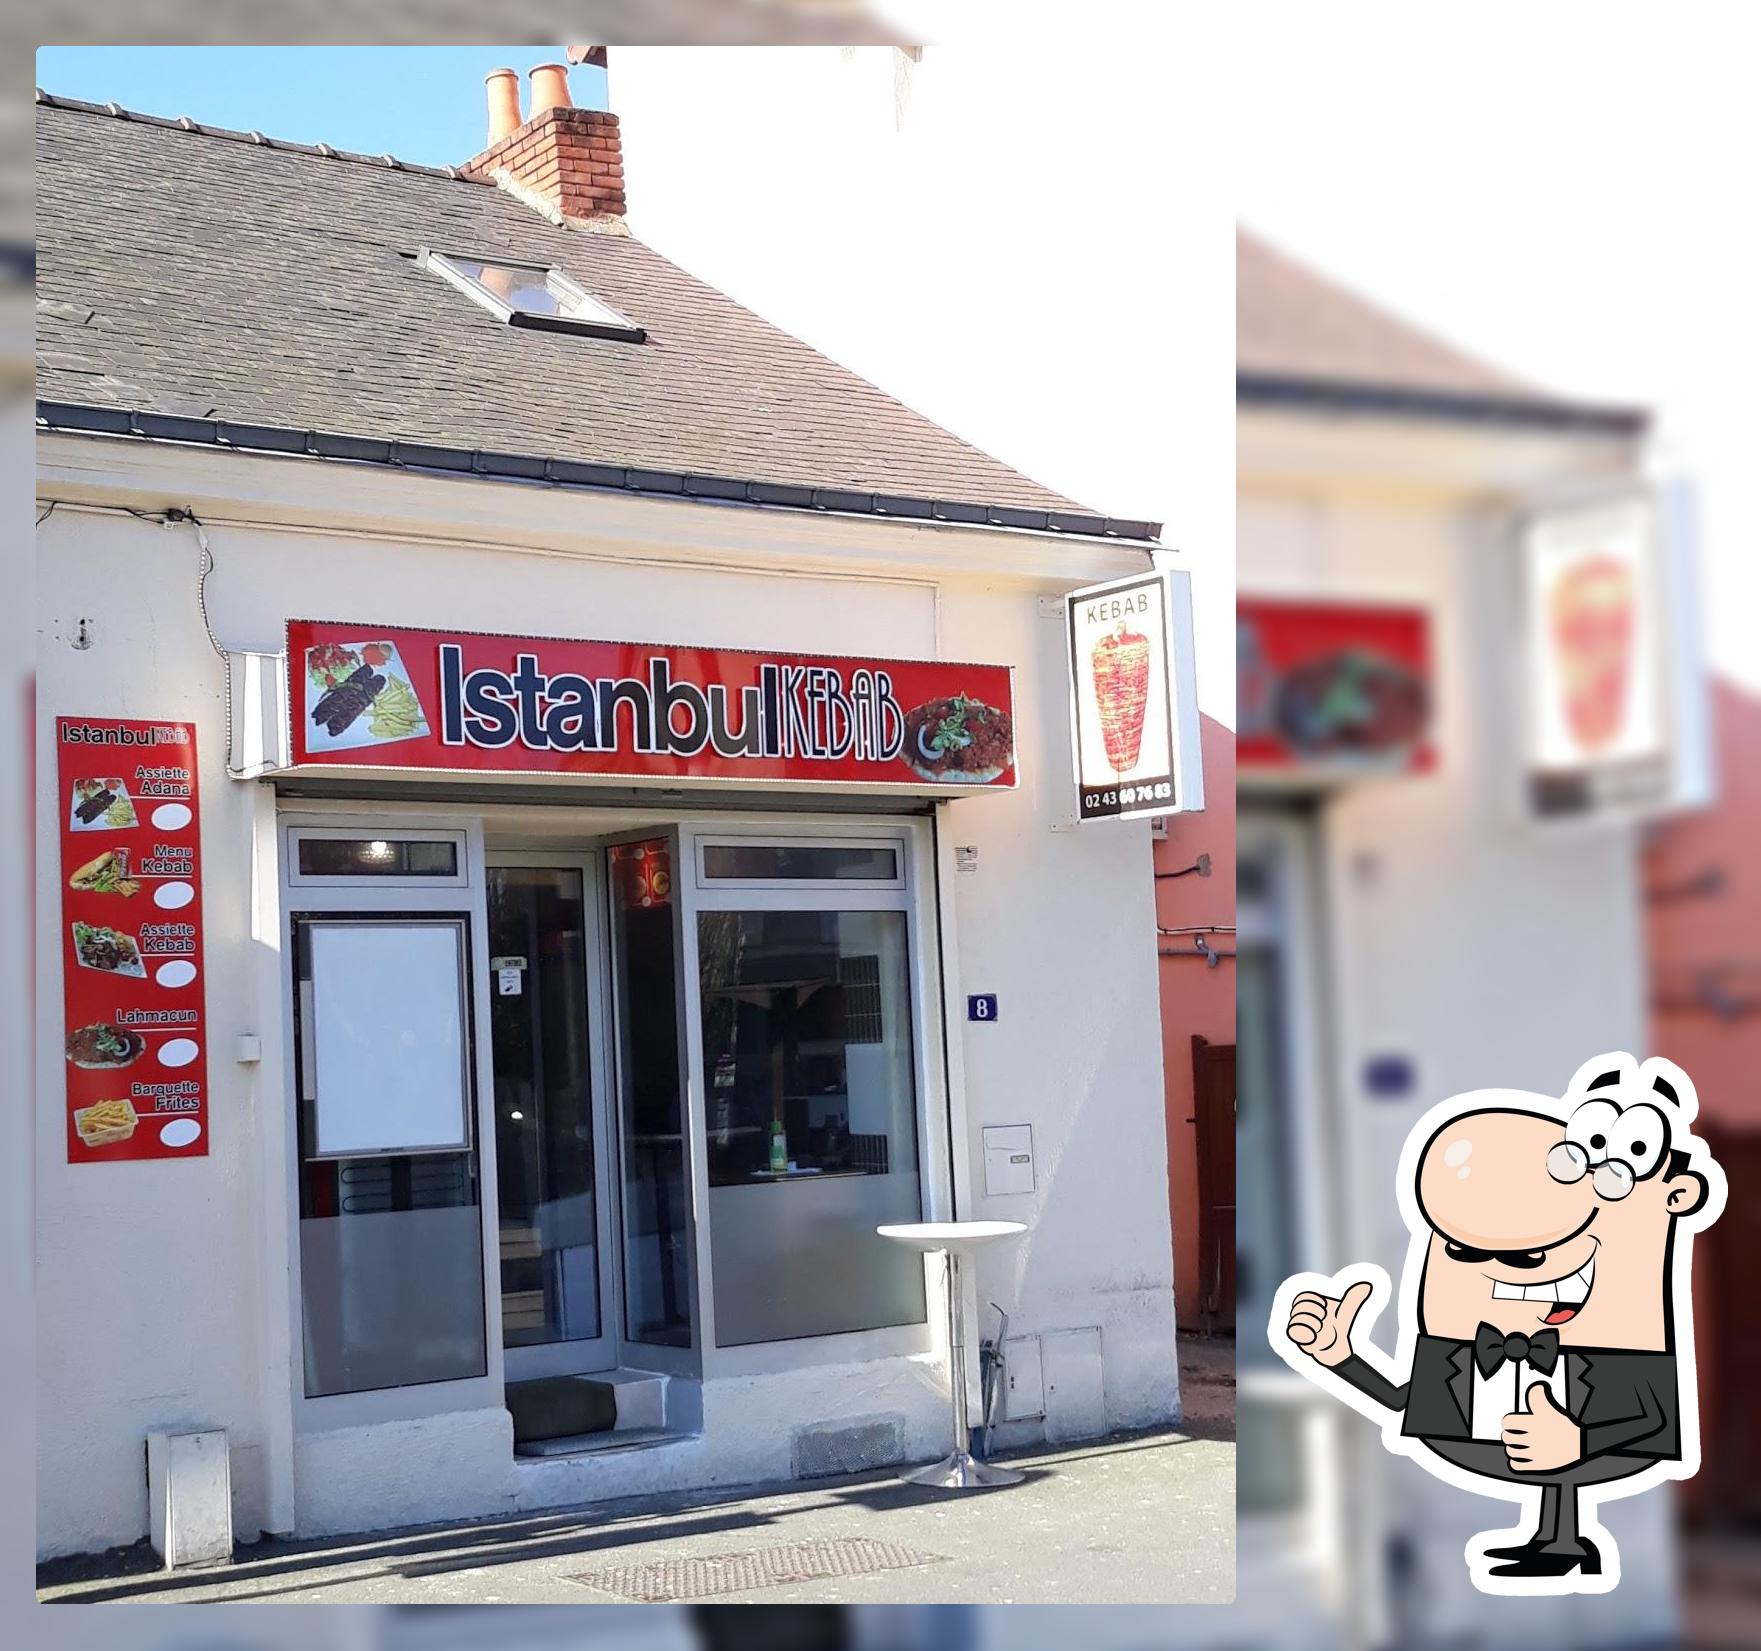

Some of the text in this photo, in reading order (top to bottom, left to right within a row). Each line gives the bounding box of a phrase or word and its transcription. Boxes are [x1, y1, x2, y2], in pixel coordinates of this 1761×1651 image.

[1087, 593, 1149, 625] KEBAB
[440, 644, 905, 761] Istanbul KEBAB
[62, 722, 156, 746] Istanbul
[135, 766, 190, 780] Assiette
[140, 781, 191, 796] Adana
[1085, 793, 1101, 808] 02
[1102, 791, 1117, 805] 43
[1119, 788, 1135, 804] 60
[1136, 785, 1153, 801] 76
[154, 844, 193, 858] Menu
[141, 859, 193, 874] Kebab
[139, 923, 195, 937] Assiette
[144, 938, 195, 952] Kebab
[975, 998, 989, 1018] 8
[116, 1009, 198, 1024] Lahmacun
[132, 1081, 199, 1097] Barquette
[155, 1096, 200, 1111] Frites
